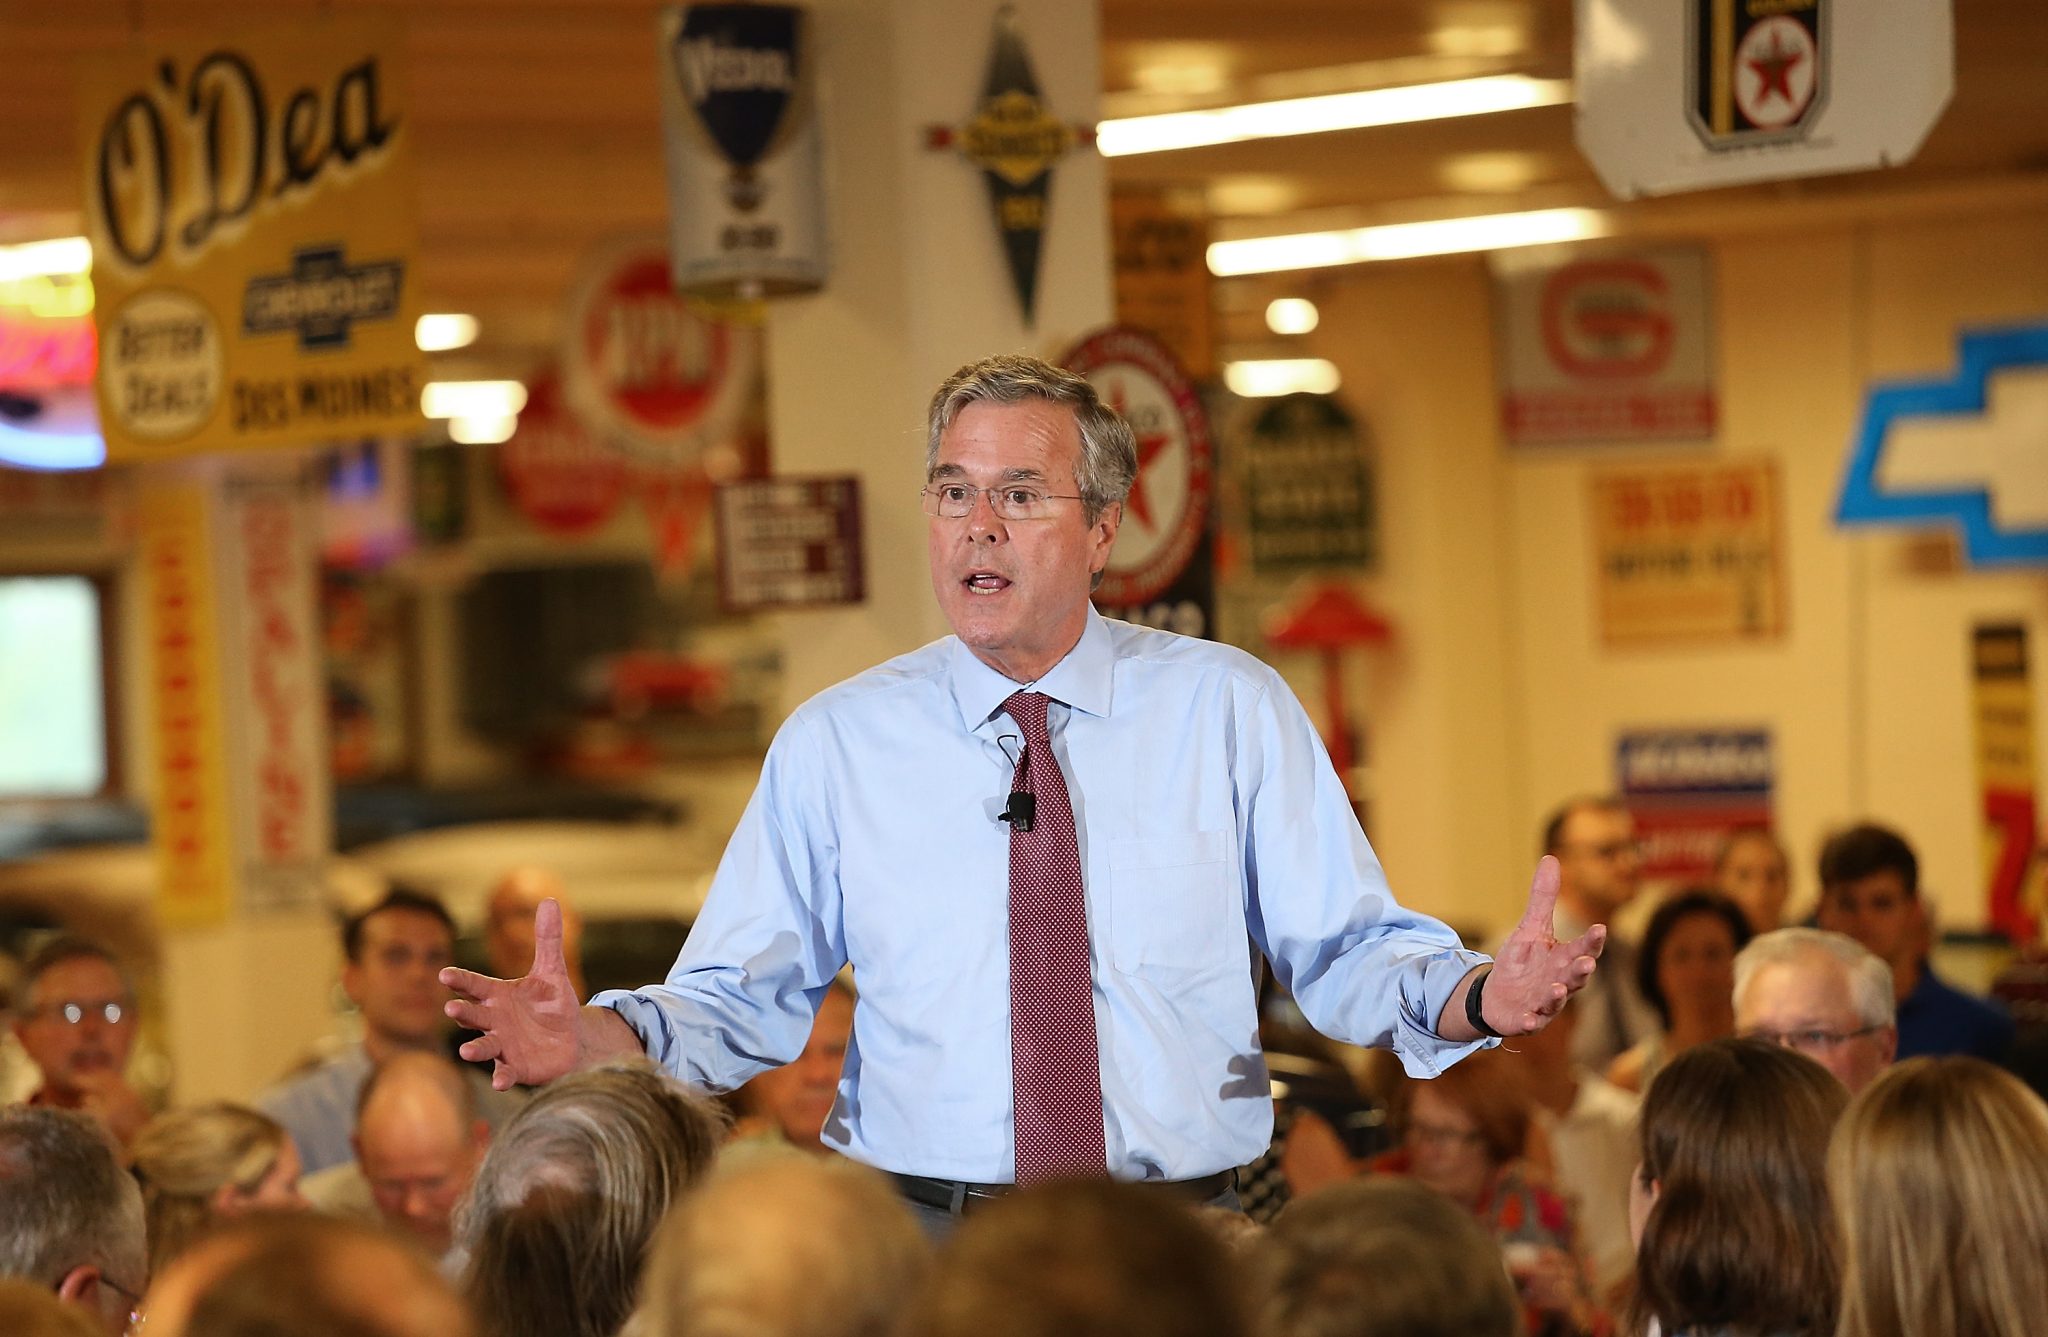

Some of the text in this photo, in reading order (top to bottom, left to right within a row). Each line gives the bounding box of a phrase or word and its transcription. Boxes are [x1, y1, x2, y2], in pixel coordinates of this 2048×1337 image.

[98, 49, 398, 267] O'Dea
[249, 268, 396, 323] CHEVROLET
[118, 320, 205, 363] BETTER
[126, 371, 209, 416] DEALS
[233, 367, 414, 430] DES MOINES
